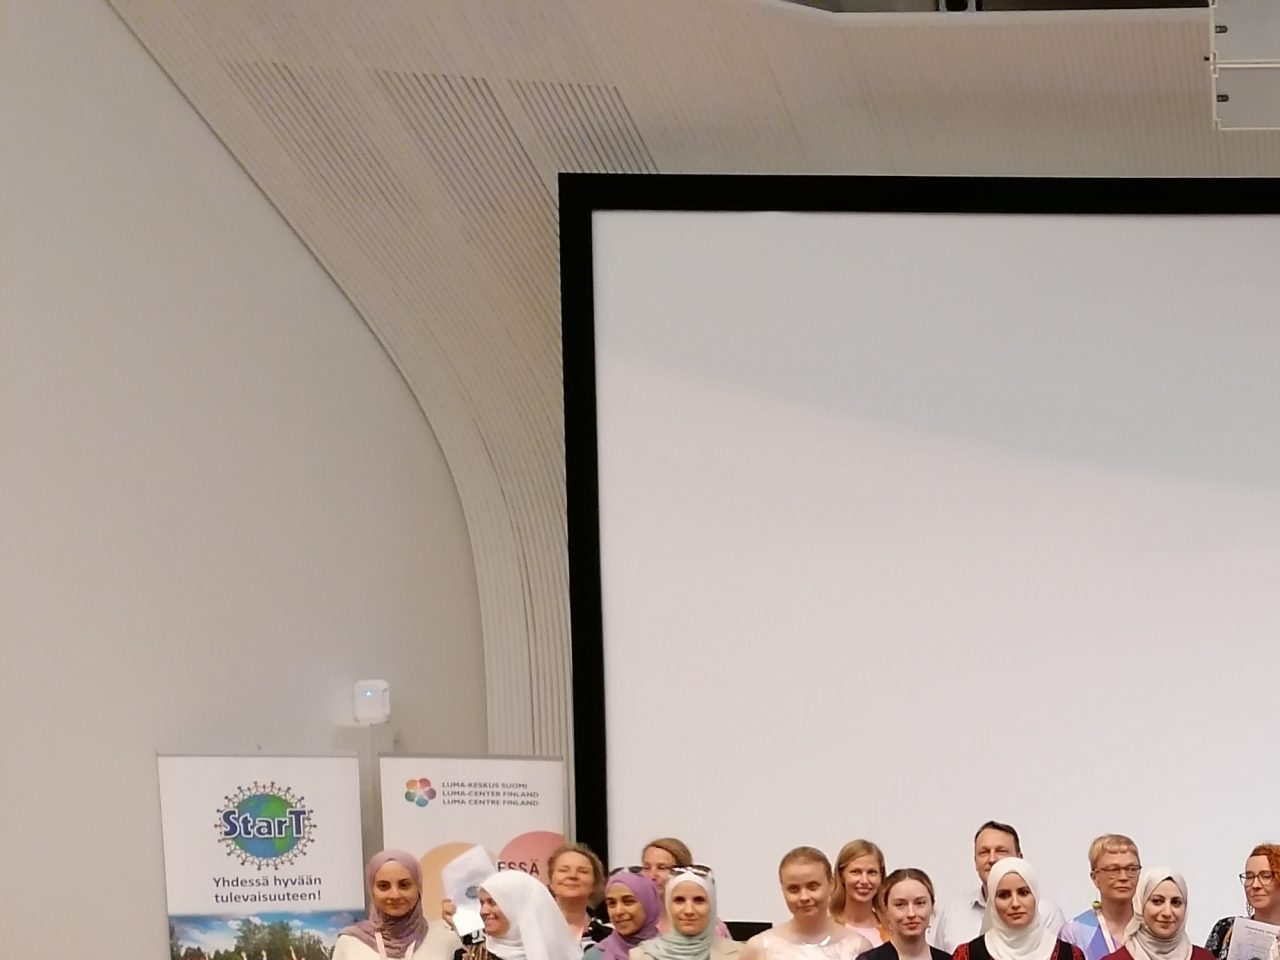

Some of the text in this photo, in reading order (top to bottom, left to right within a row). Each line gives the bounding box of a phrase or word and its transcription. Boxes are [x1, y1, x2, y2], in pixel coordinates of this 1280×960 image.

[441, 781, 500, 789] LUMA-KESKUS
[221, 808, 307, 838] StarT
[213, 875, 322, 888] Yhdessä hyvään
[214, 889, 322, 904] tulevaisuuteen!
